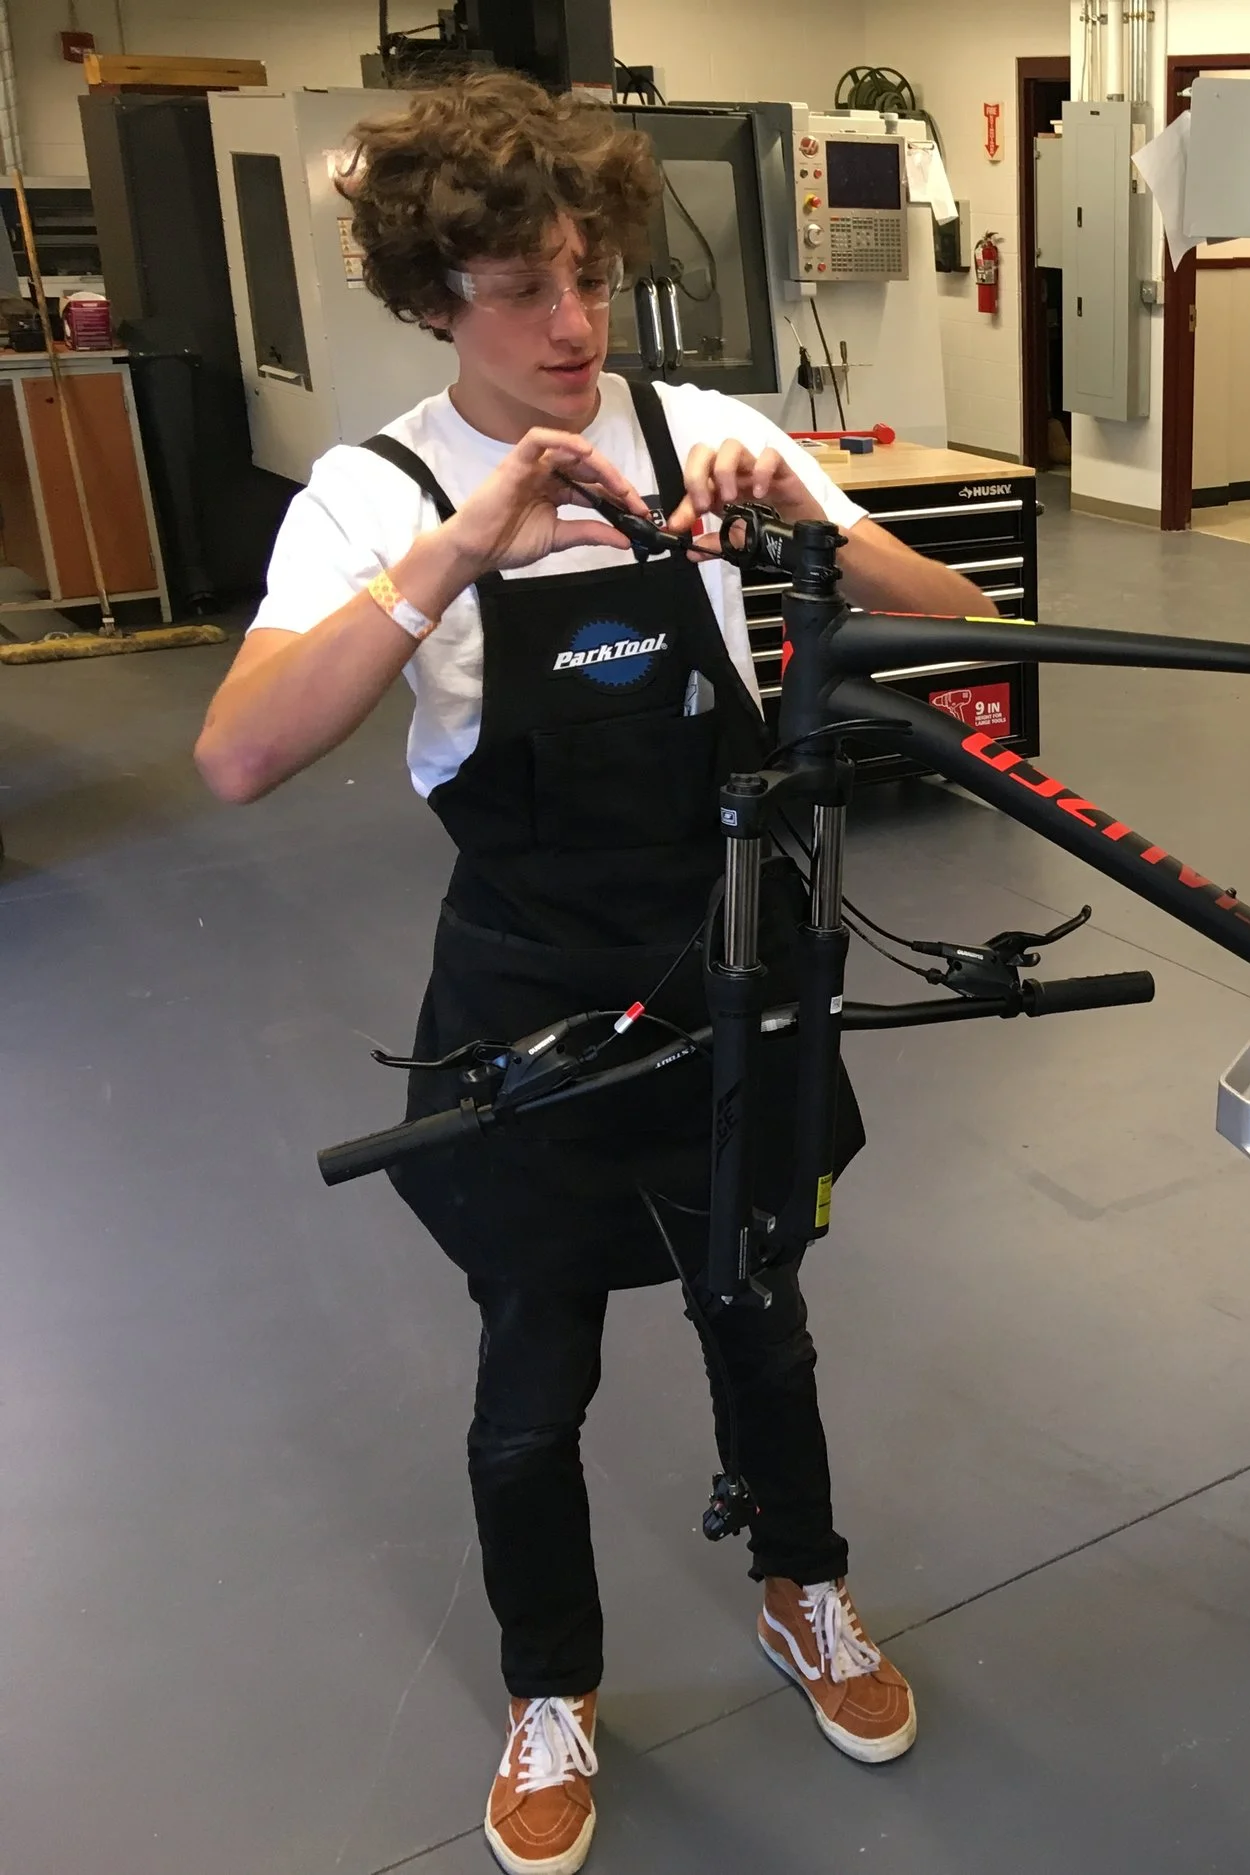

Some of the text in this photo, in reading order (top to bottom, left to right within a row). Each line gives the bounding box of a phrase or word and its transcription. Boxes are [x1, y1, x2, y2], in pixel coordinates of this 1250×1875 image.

[972, 484, 1012, 497] HUSKY
[975, 701, 1000, 716] 9 IN
